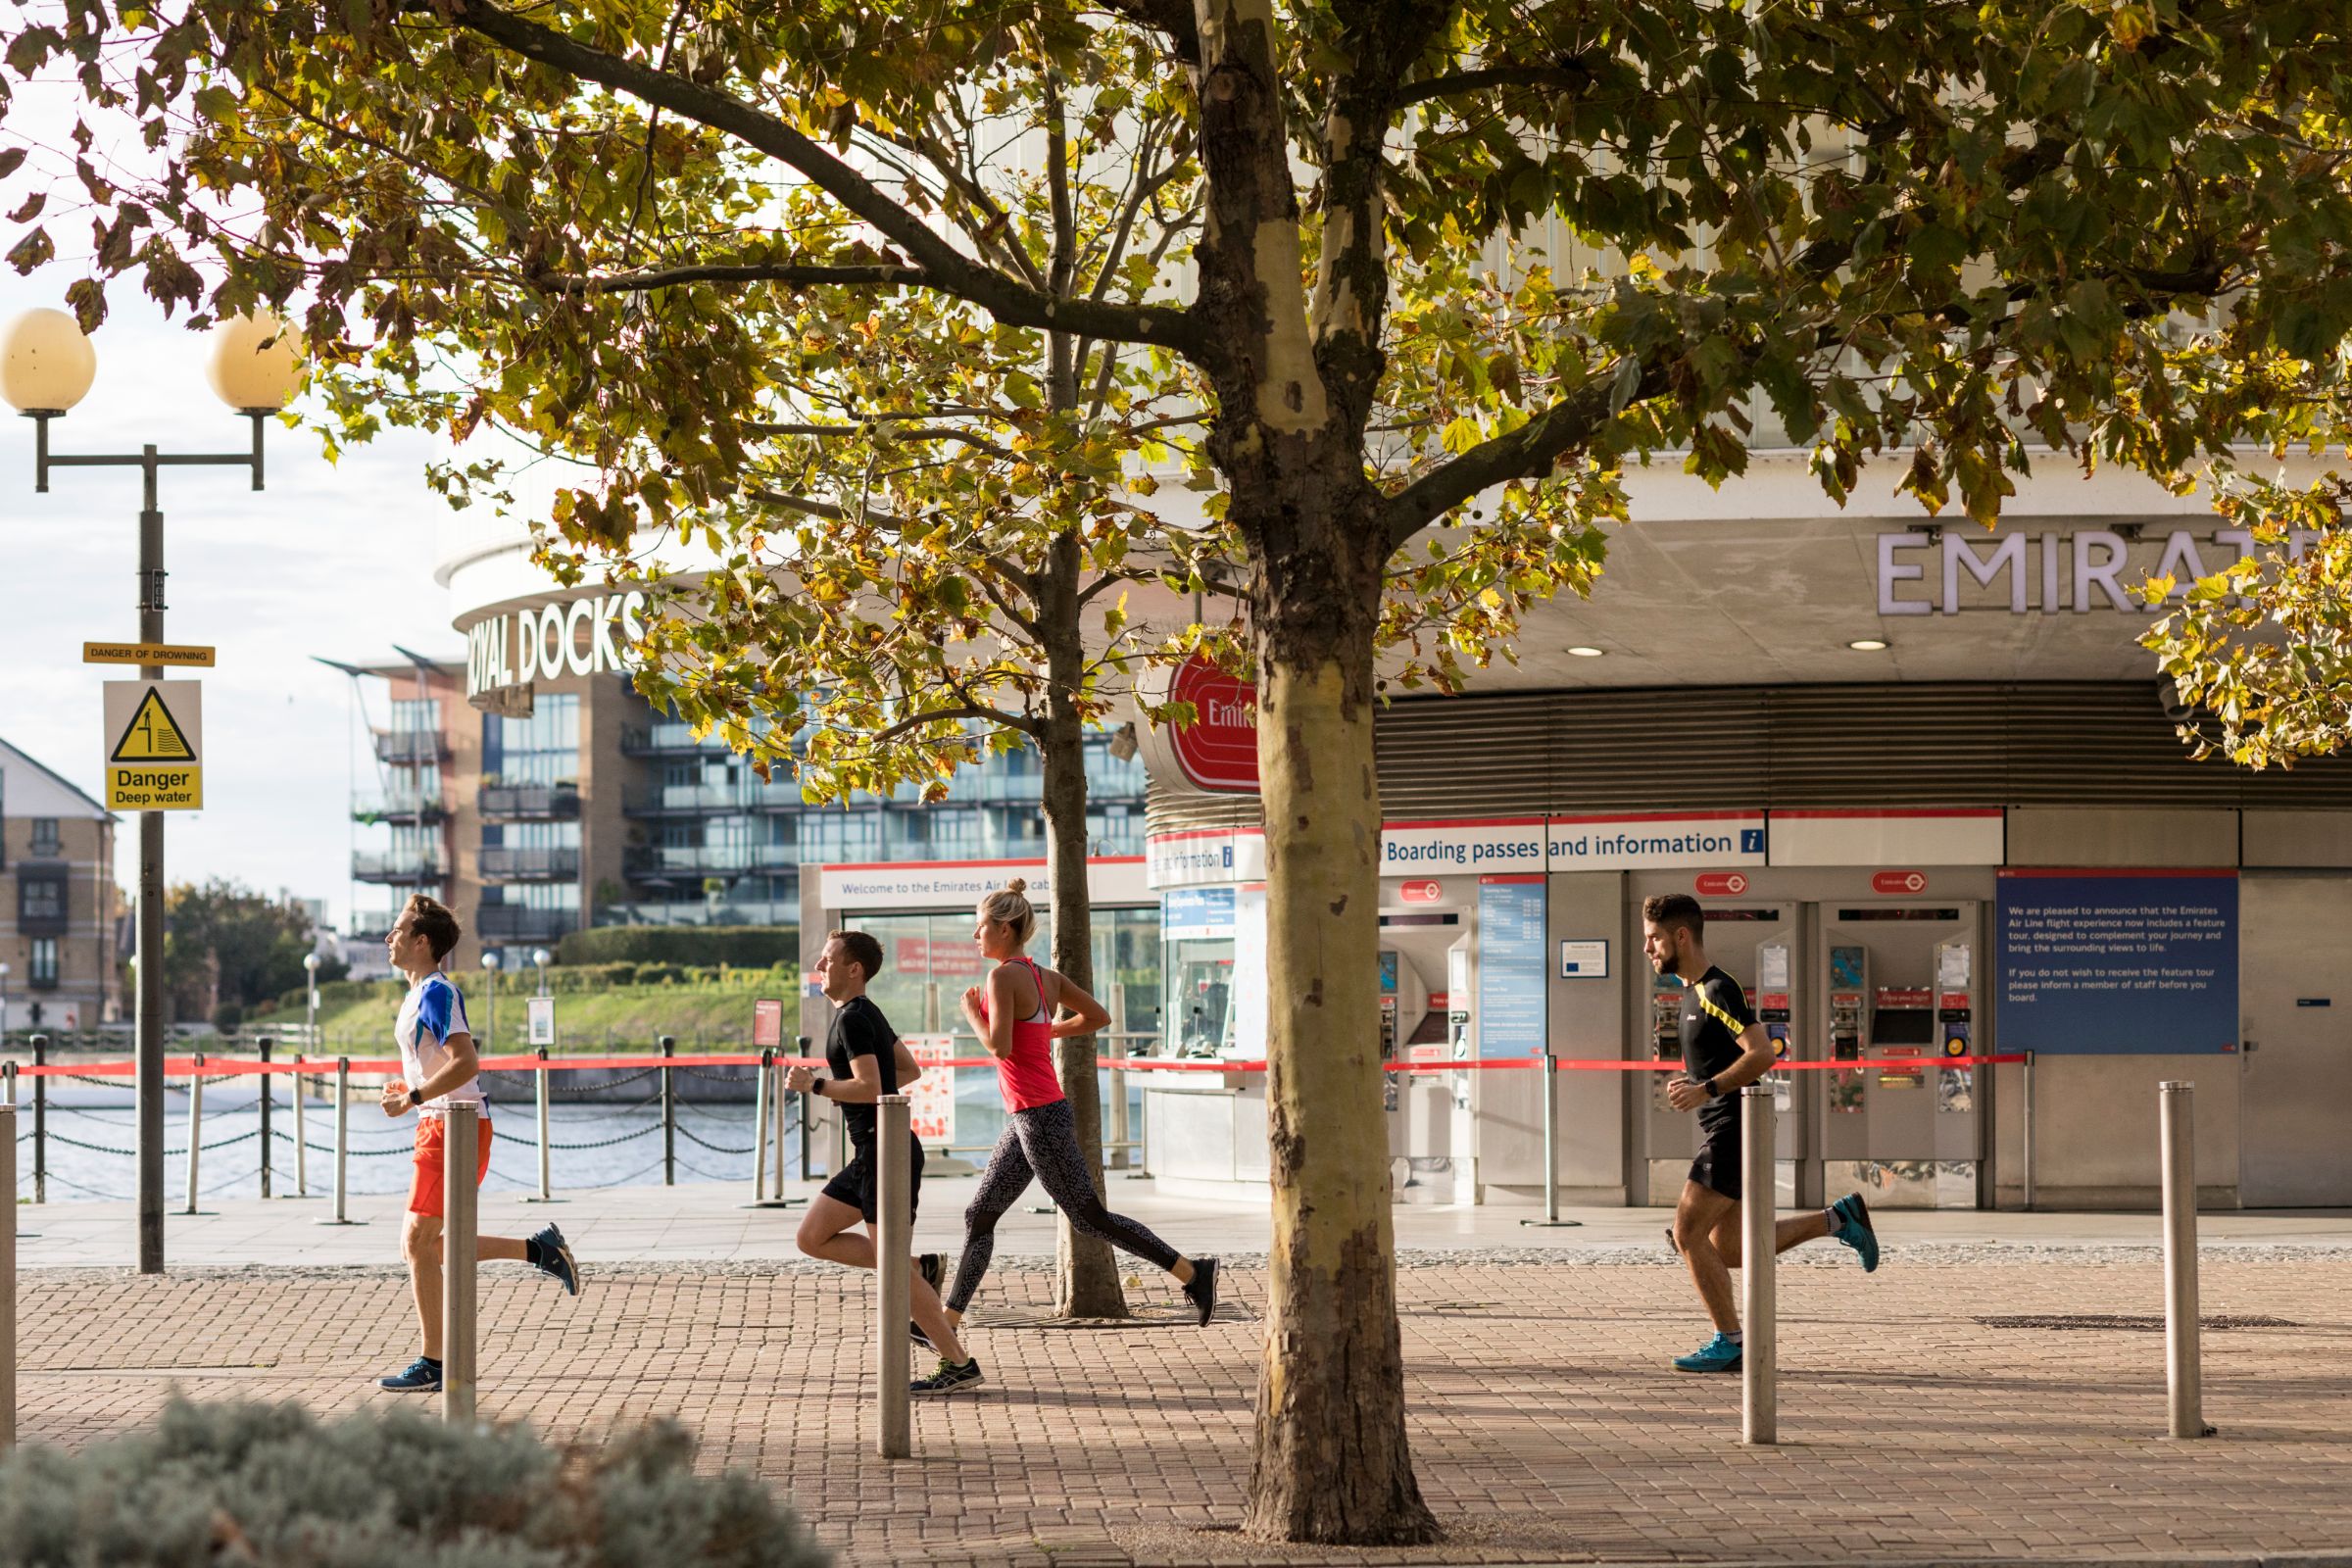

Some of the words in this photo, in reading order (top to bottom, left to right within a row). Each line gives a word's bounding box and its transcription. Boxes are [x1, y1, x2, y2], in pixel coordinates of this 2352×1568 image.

[518, 590, 648, 683] DOCKS
[90, 648, 132, 659] DANGER
[135, 650, 149, 659] OF
[153, 651, 207, 662] DROWNING
[118, 770, 189, 790] Danger
[116, 791, 151, 805] Deep
[154, 792, 192, 803] water
[1388, 840, 1466, 864] Boarding
[1473, 841, 1540, 863] passes
[1548, 836, 1587, 857] and
[1595, 833, 1732, 856] information
[842, 883, 893, 895] Welcome
[897, 884, 908, 894] to
[911, 882, 930, 894] the
[934, 881, 981, 893] Emirates
[985, 880, 1001, 890] Air
[1031, 878, 1050, 890] cab
[2008, 907, 2024, 915] We
[2043, 906, 2078, 917] pleased
[2081, 907, 2092, 915] to
[2140, 906, 2159, 915] that
[2180, 906, 2218, 915] Emirates
[2008, 919, 2022, 927] Air
[2025, 919, 2044, 928] Line
[2046, 919, 2070, 929] flight
[2073, 919, 2122, 929] experience
[2147, 919, 2183, 927] includes
[2193, 918, 2225, 927] feature
[2033, 931, 2073, 942] designed
[2089, 931, 2145, 941] complement
[2148, 932, 2167, 941] your
[2170, 932, 2203, 941] journey
[2008, 944, 2031, 954] bring
[2034, 944, 2050, 952] the
[2052, 943, 2106, 954] surrounding
[2108, 944, 2134, 952] views
[2149, 943, 2166, 952] life.
[2009, 968, 2016, 977] If
[2019, 970, 2036, 979] you
[2038, 968, 2050, 977] do
[2053, 969, 2068, 977] not
[2071, 968, 2092, 977] wish
[2108, 968, 2140, 977] receive
[2143, 968, 2158, 976] the
[2161, 968, 2194, 976] feature
[2009, 981, 2038, 991] please
[2041, 980, 2071, 989] inform
[2081, 980, 2118, 989] member
[2121, 980, 2131, 989] of
[2134, 980, 2156, 989] staff
[2159, 980, 2188, 989] before
[2191, 982, 2206, 990] you
[2009, 993, 2037, 1002] board.
